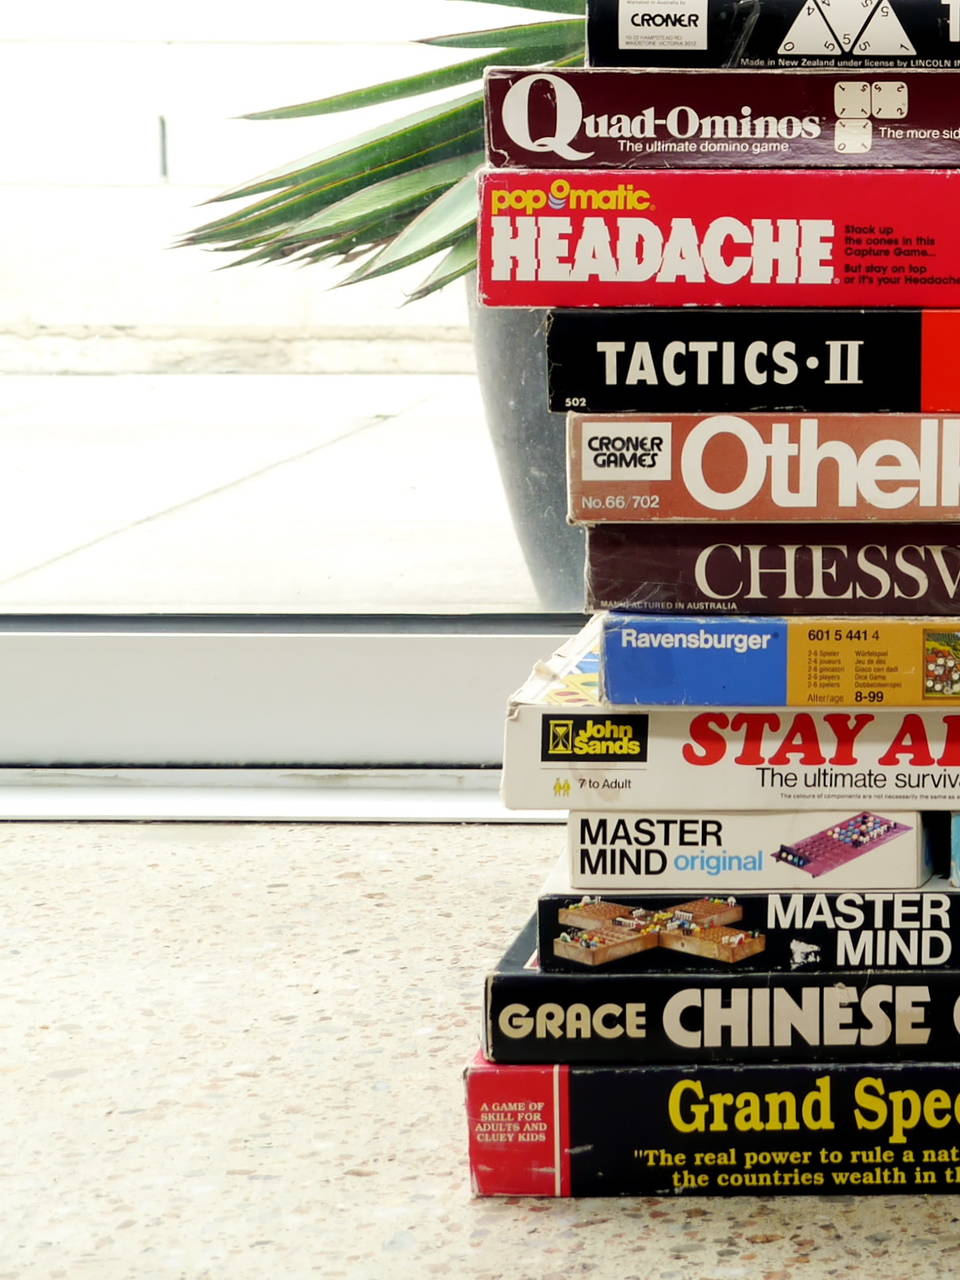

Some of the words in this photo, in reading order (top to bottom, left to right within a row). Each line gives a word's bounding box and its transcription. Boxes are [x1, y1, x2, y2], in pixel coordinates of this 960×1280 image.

[631, 13, 699, 27] CRONER
[801, 58, 835, 67] Zealand
[910, 59, 952, 67] LINCOLN
[501, 73, 822, 161] Quad-Ominos
[646, 139, 697, 152] ultimate
[491, 216, 835, 285] HEADACHE
[844, 248, 892, 259] Capture
[565, 398, 587, 407] 502
[587, 436, 663, 452] CRONER
[593, 452, 659, 469] GAMES
[687, 602, 737, 610] AUSTRALIA
[621, 629, 771, 653] Ravensburger
[808, 630, 830, 640] 601
[855, 691, 884, 702] 8-99
[579, 720, 633, 740] John
[573, 737, 641, 756] Sands
[682, 713, 875, 766] STAY
[603, 778, 631, 790] Adult
[803, 767, 887, 788] ultimate
[579, 818, 723, 846] MASTER
[579, 849, 668, 875] MIND
[673, 850, 763, 876] original
[767, 894, 951, 930] MASTER
[836, 930, 952, 967] MIND
[498, 1003, 646, 1040] GRACE
[662, 985, 931, 1048] CHINESE
[667, 1075, 835, 1133] Grand
[475, 1123, 521, 1132] ADULTS
[477, 1133, 515, 1142] CLUEY
[744, 1151, 812, 1169] power
[717, 1169, 824, 1187] countries
[832, 1168, 907, 1185] wealth
